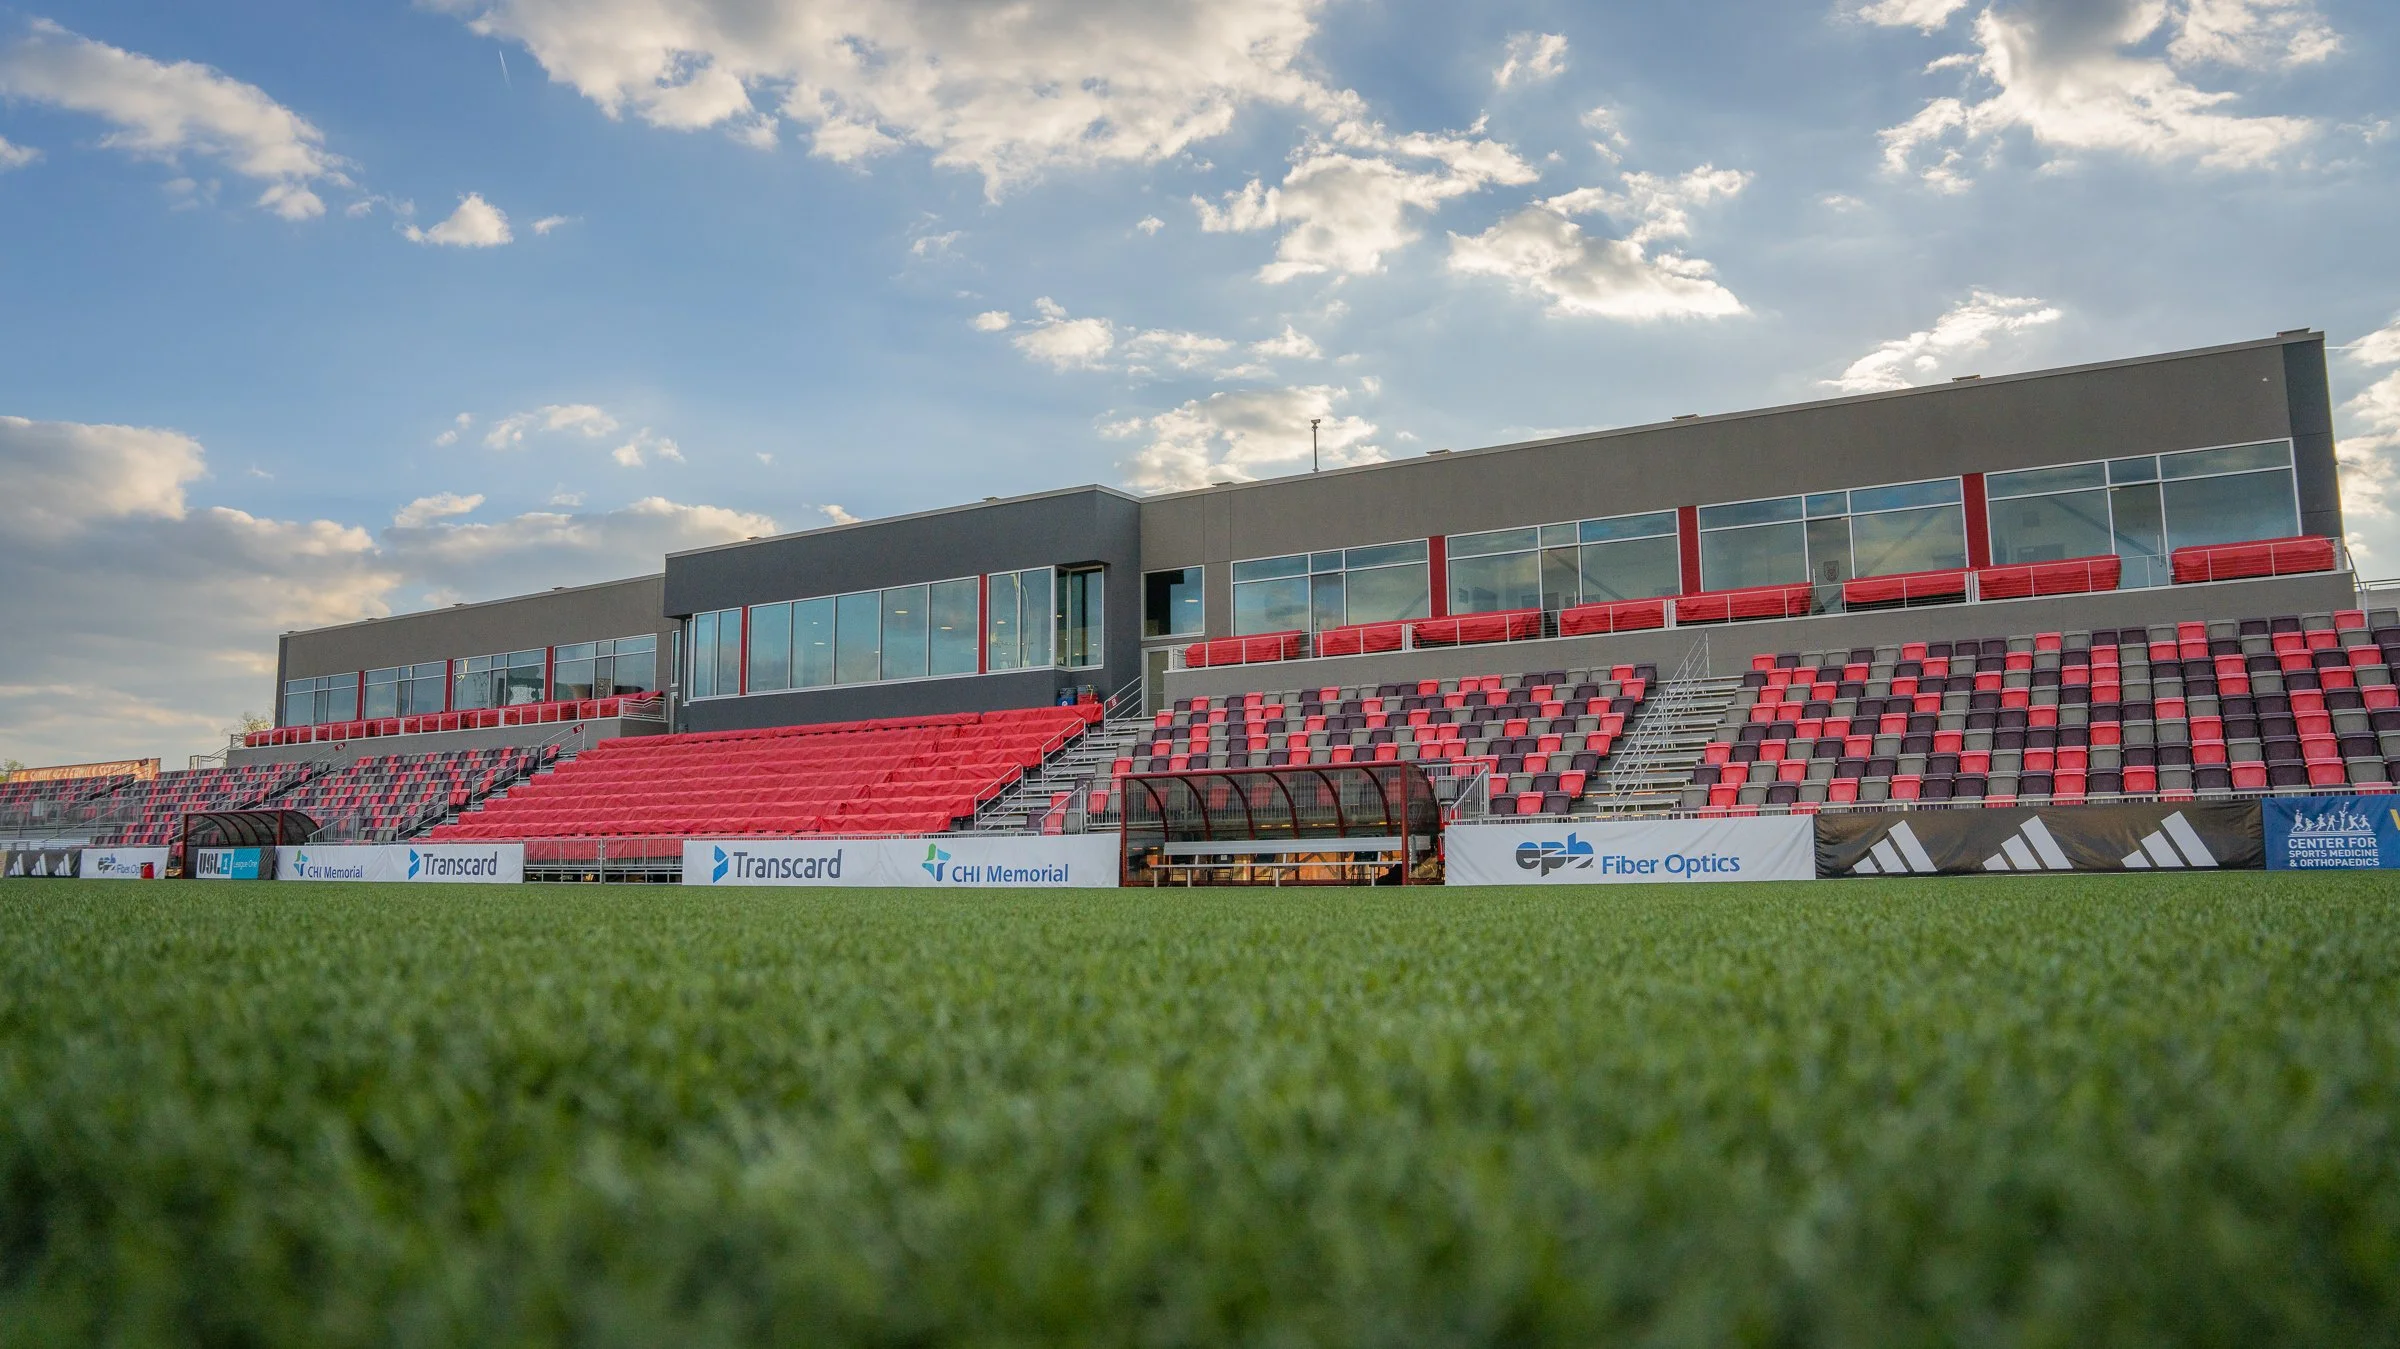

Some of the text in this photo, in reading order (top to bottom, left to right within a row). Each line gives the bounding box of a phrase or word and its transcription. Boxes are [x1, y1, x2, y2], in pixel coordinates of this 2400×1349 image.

[2288, 837, 2378, 849] CENTER FOR
[2288, 848, 2379, 858] SPORTS MEDICINE
[2289, 858, 2380, 867] & ORTHOPAEDICS
[199, 853, 221, 874] USL
[308, 865, 363, 878] CHI Memorial
[423, 851, 498, 876] Transcard
[733, 849, 842, 879] Transcard
[952, 863, 1069, 882] CHI Memorial
[1602, 855, 1659, 875] Fiber
[1664, 853, 1741, 879] Optics
